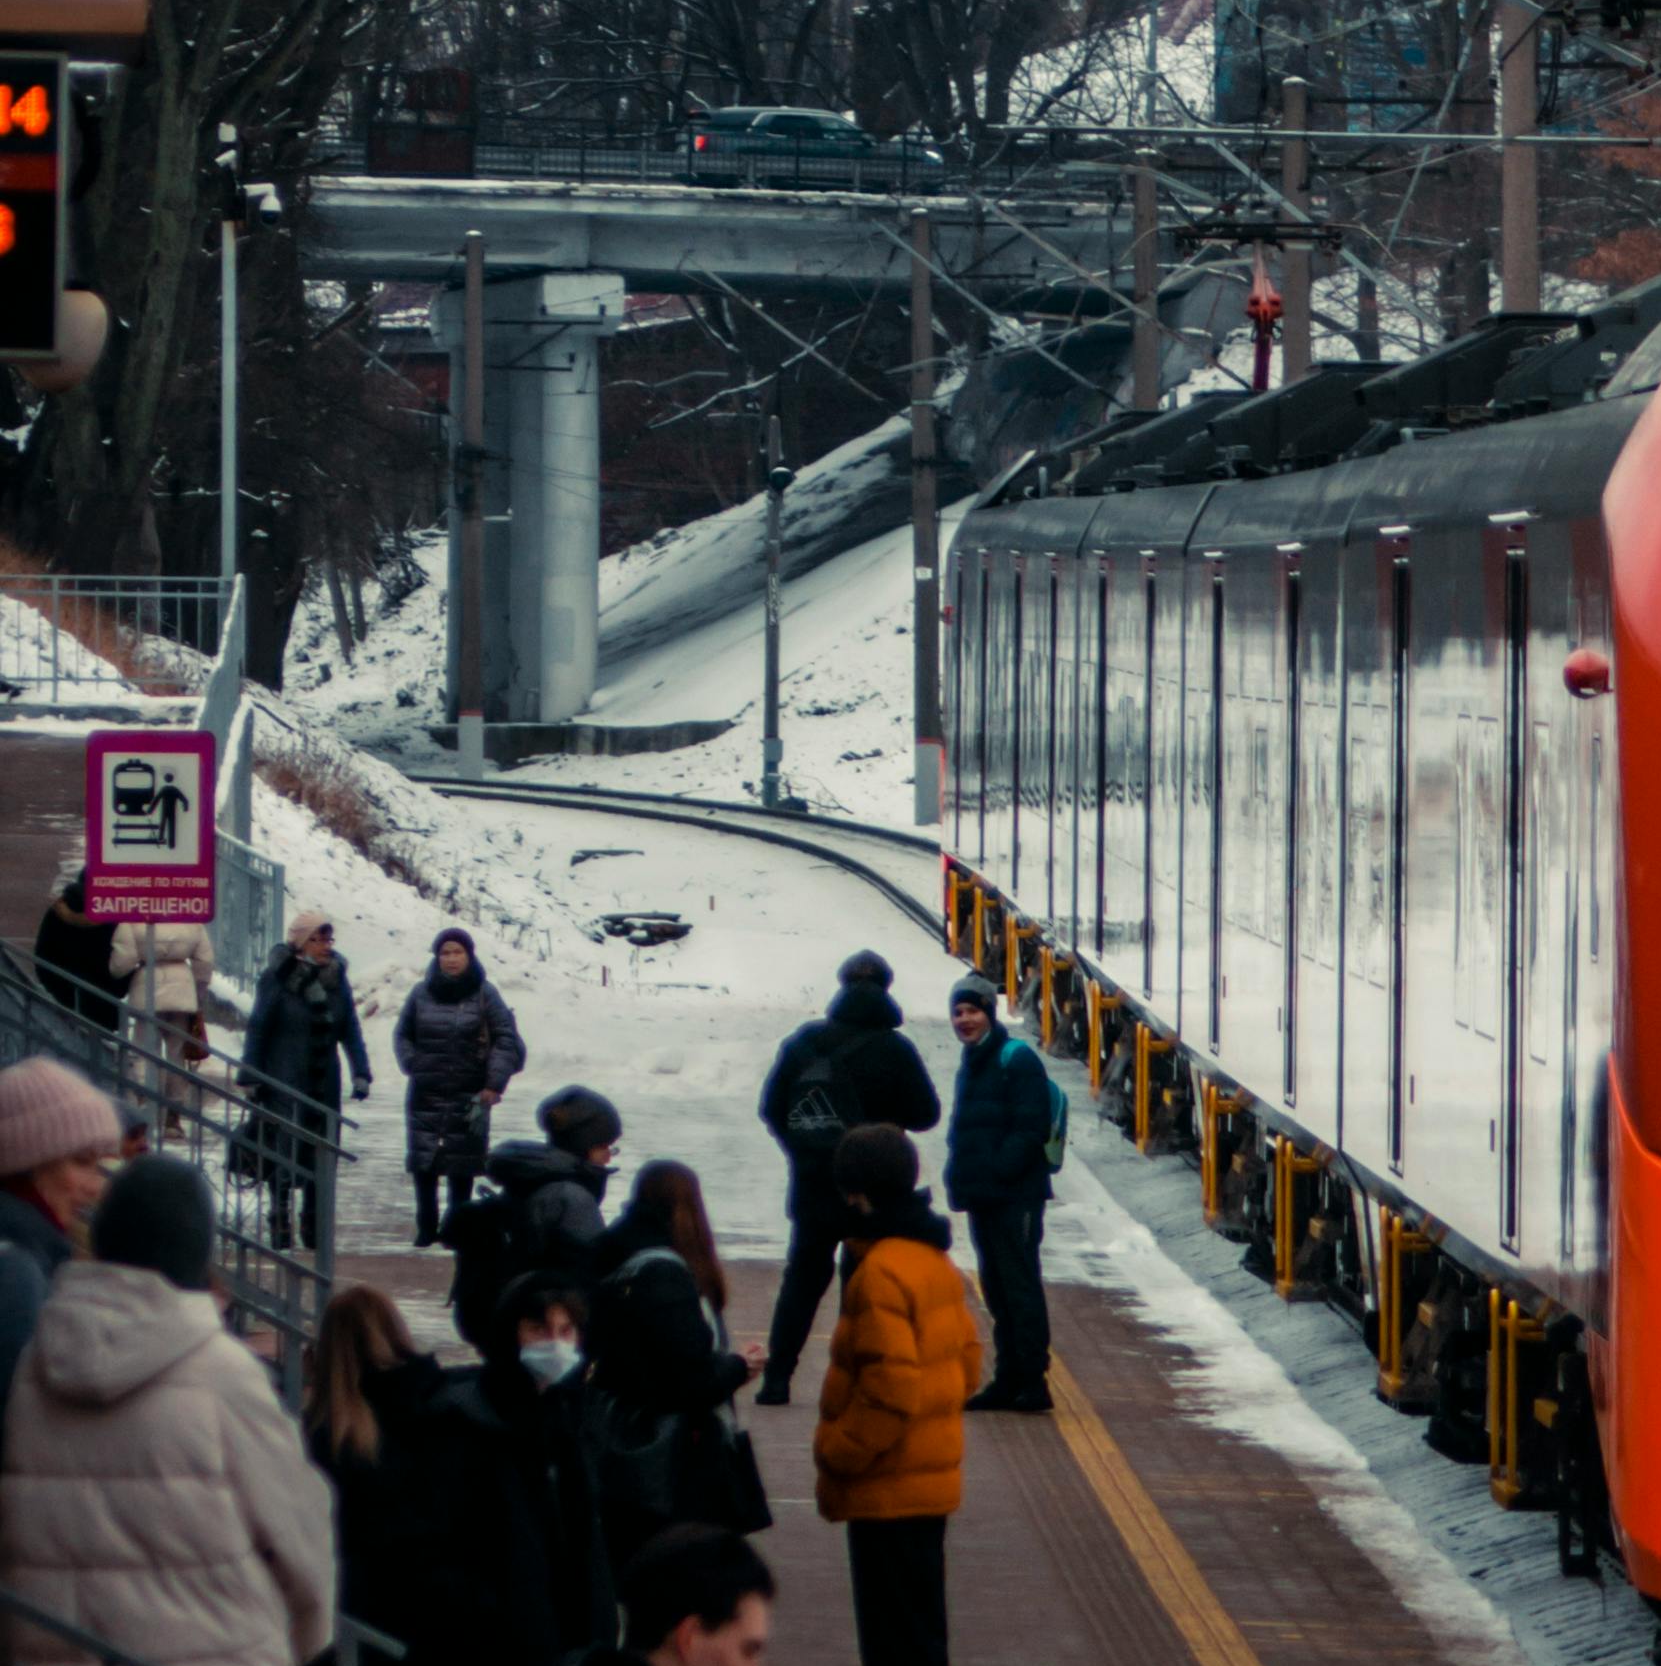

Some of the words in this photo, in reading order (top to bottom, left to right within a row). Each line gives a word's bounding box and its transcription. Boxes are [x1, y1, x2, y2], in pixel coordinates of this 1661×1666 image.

[154, 877, 171, 888] ПО
[172, 877, 209, 888] ПУТЯМ
[92, 897, 209, 915] ЗАПРЕЩЕНО!
